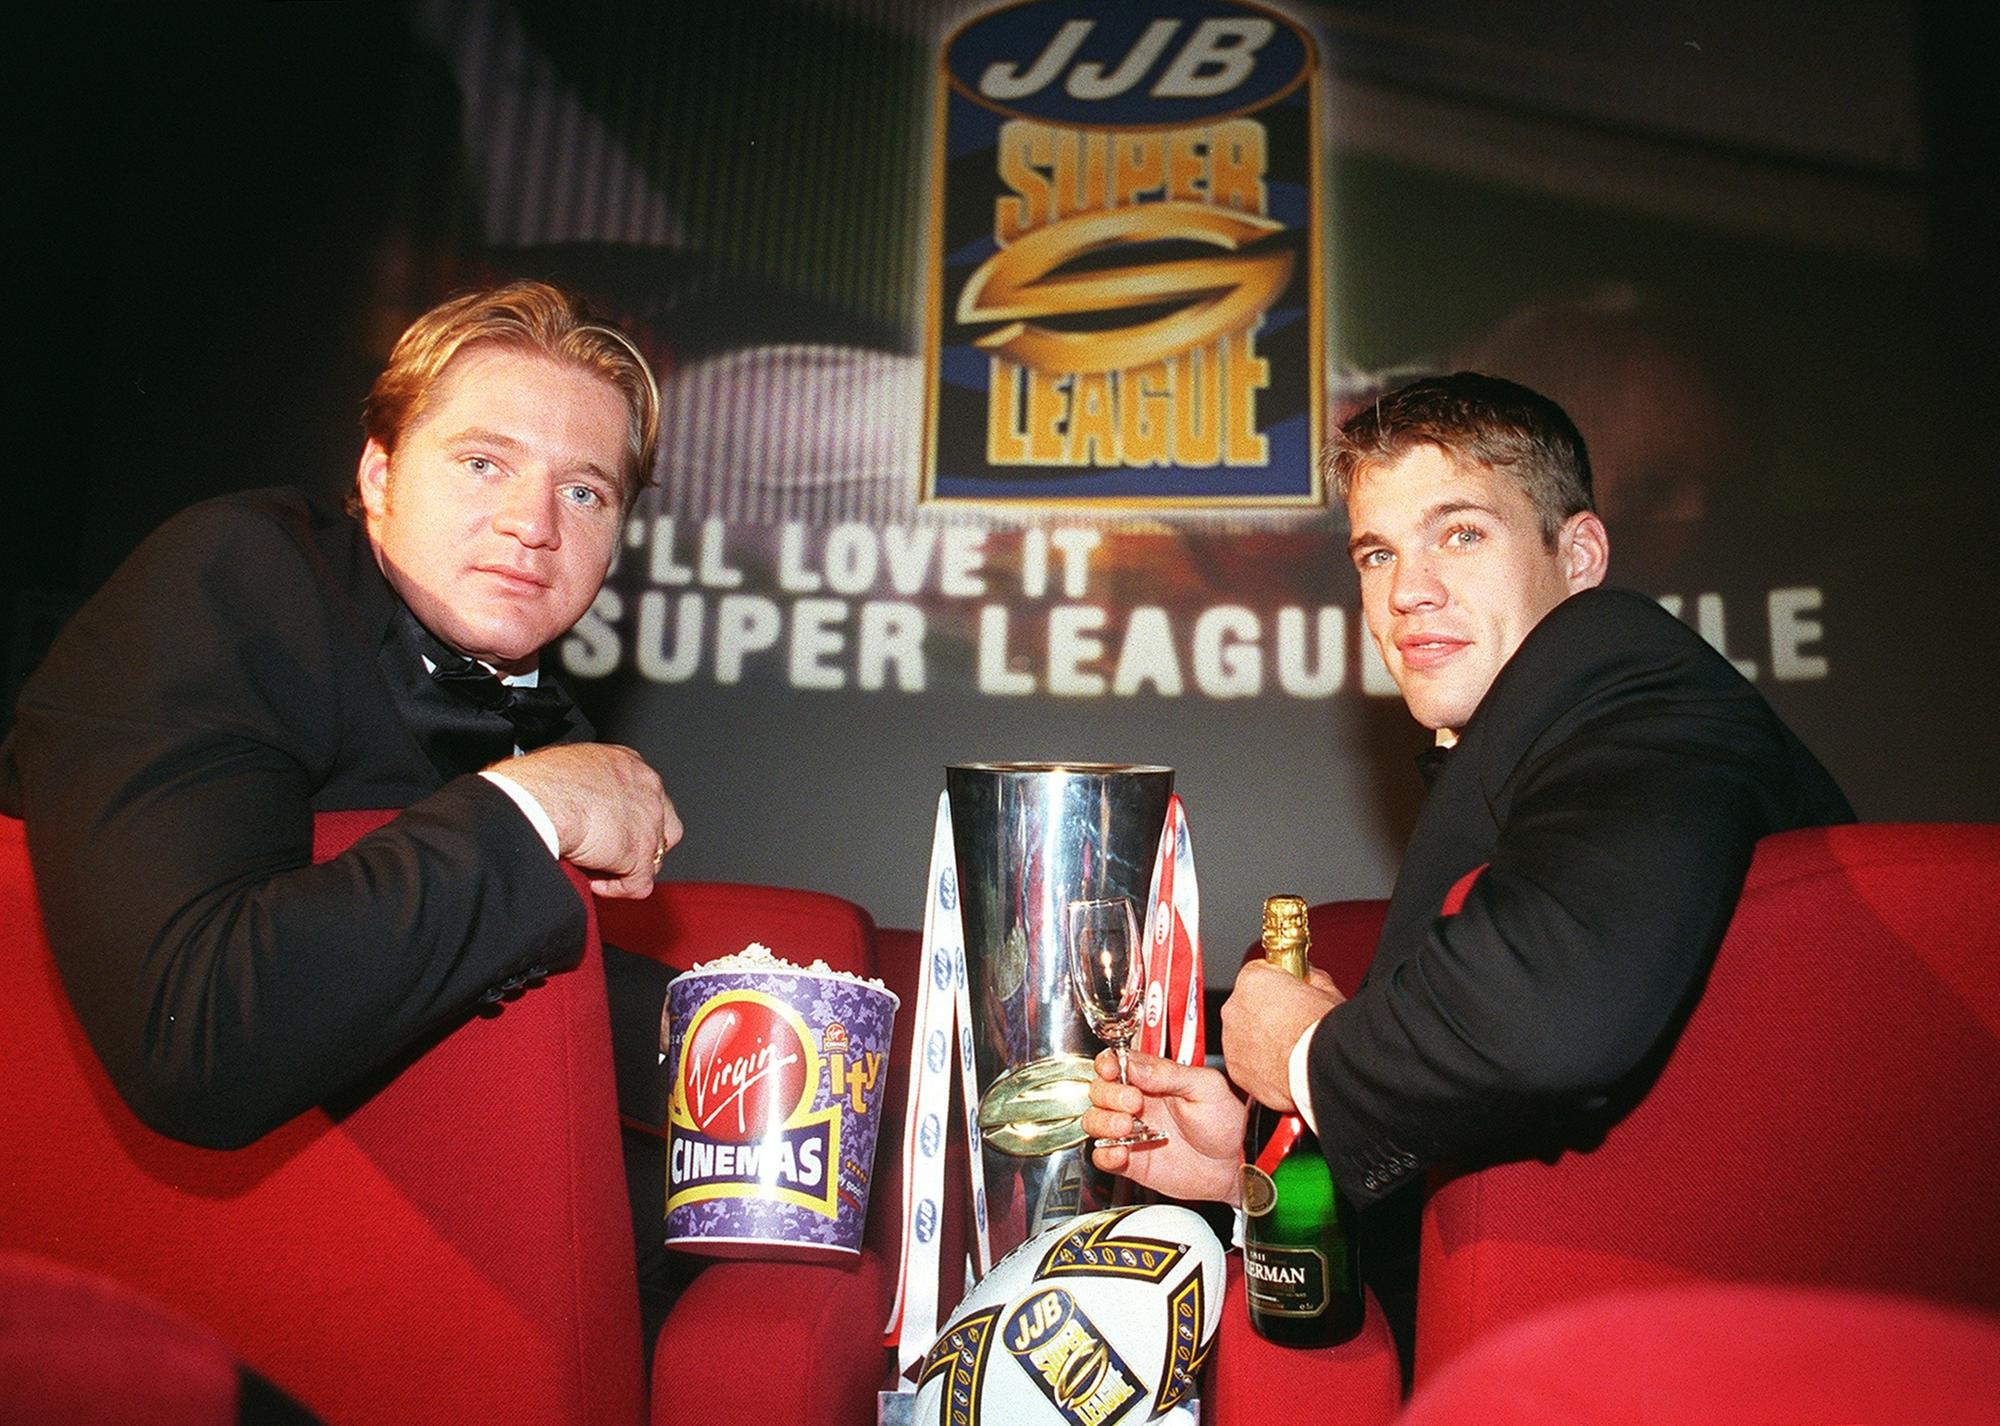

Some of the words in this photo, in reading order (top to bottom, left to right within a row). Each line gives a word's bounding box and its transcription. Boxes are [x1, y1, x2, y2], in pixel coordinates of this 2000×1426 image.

[978, 17, 1276, 99] JJB
[995, 117, 1268, 248] SUPER
[986, 312, 1271, 468] LEAGUE
[606, 516, 743, 588] 'LL
[779, 519, 987, 598] LOVE
[1022, 526, 1101, 599] IT
[560, 586, 927, 693] SUPER
[1656, 586, 1829, 684] LE
[688, 1012, 797, 1134] Virgin
[671, 1137, 822, 1186] CINEMAS
[1014, 1291, 1063, 1351] JJB
